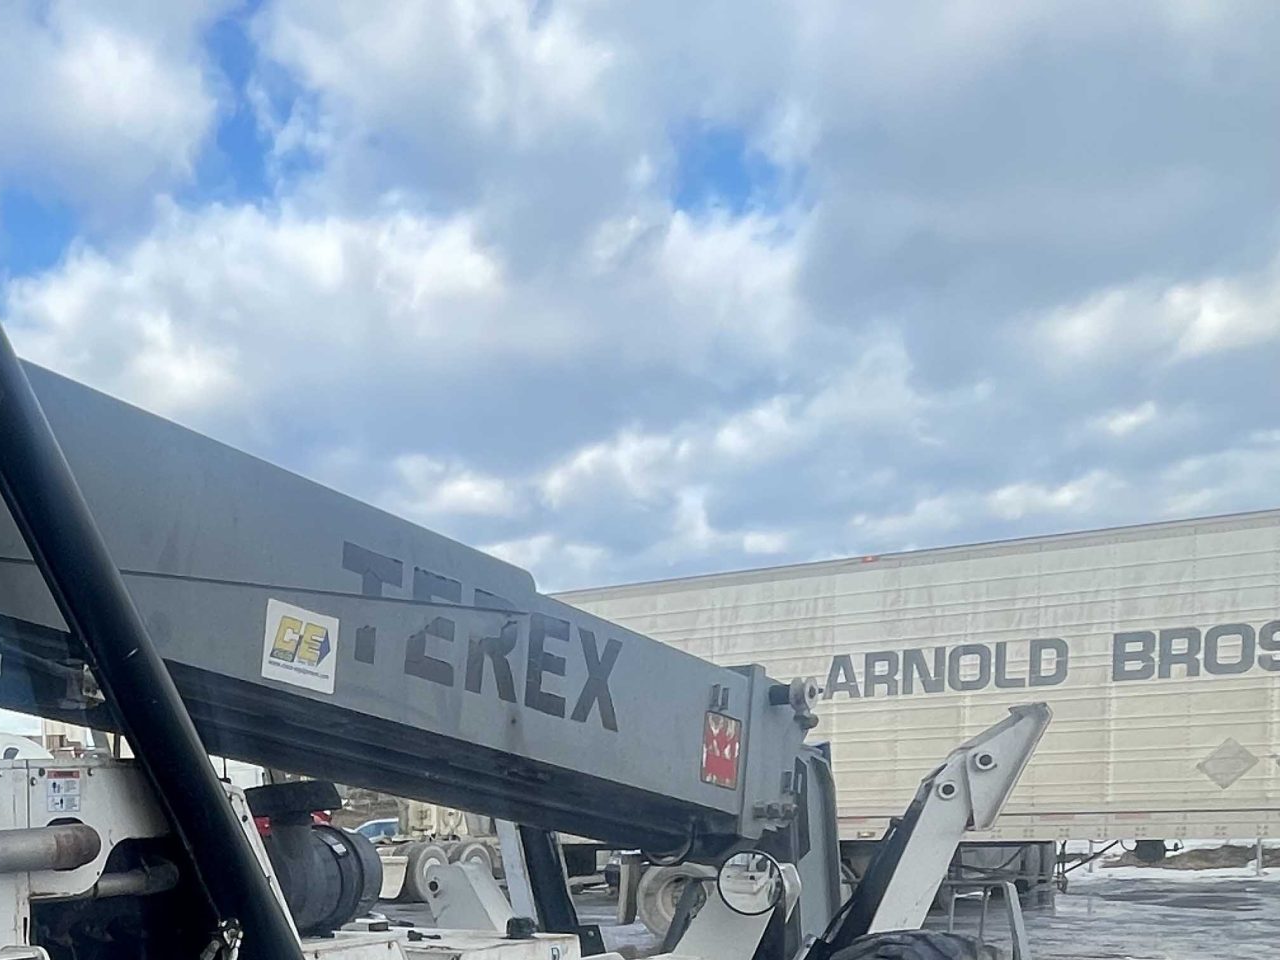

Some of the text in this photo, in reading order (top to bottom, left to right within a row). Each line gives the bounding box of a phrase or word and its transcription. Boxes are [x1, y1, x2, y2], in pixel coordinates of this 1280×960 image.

[341, 541, 623, 732] TEREX
[824, 620, 1280, 700] ARNOLD BROS
